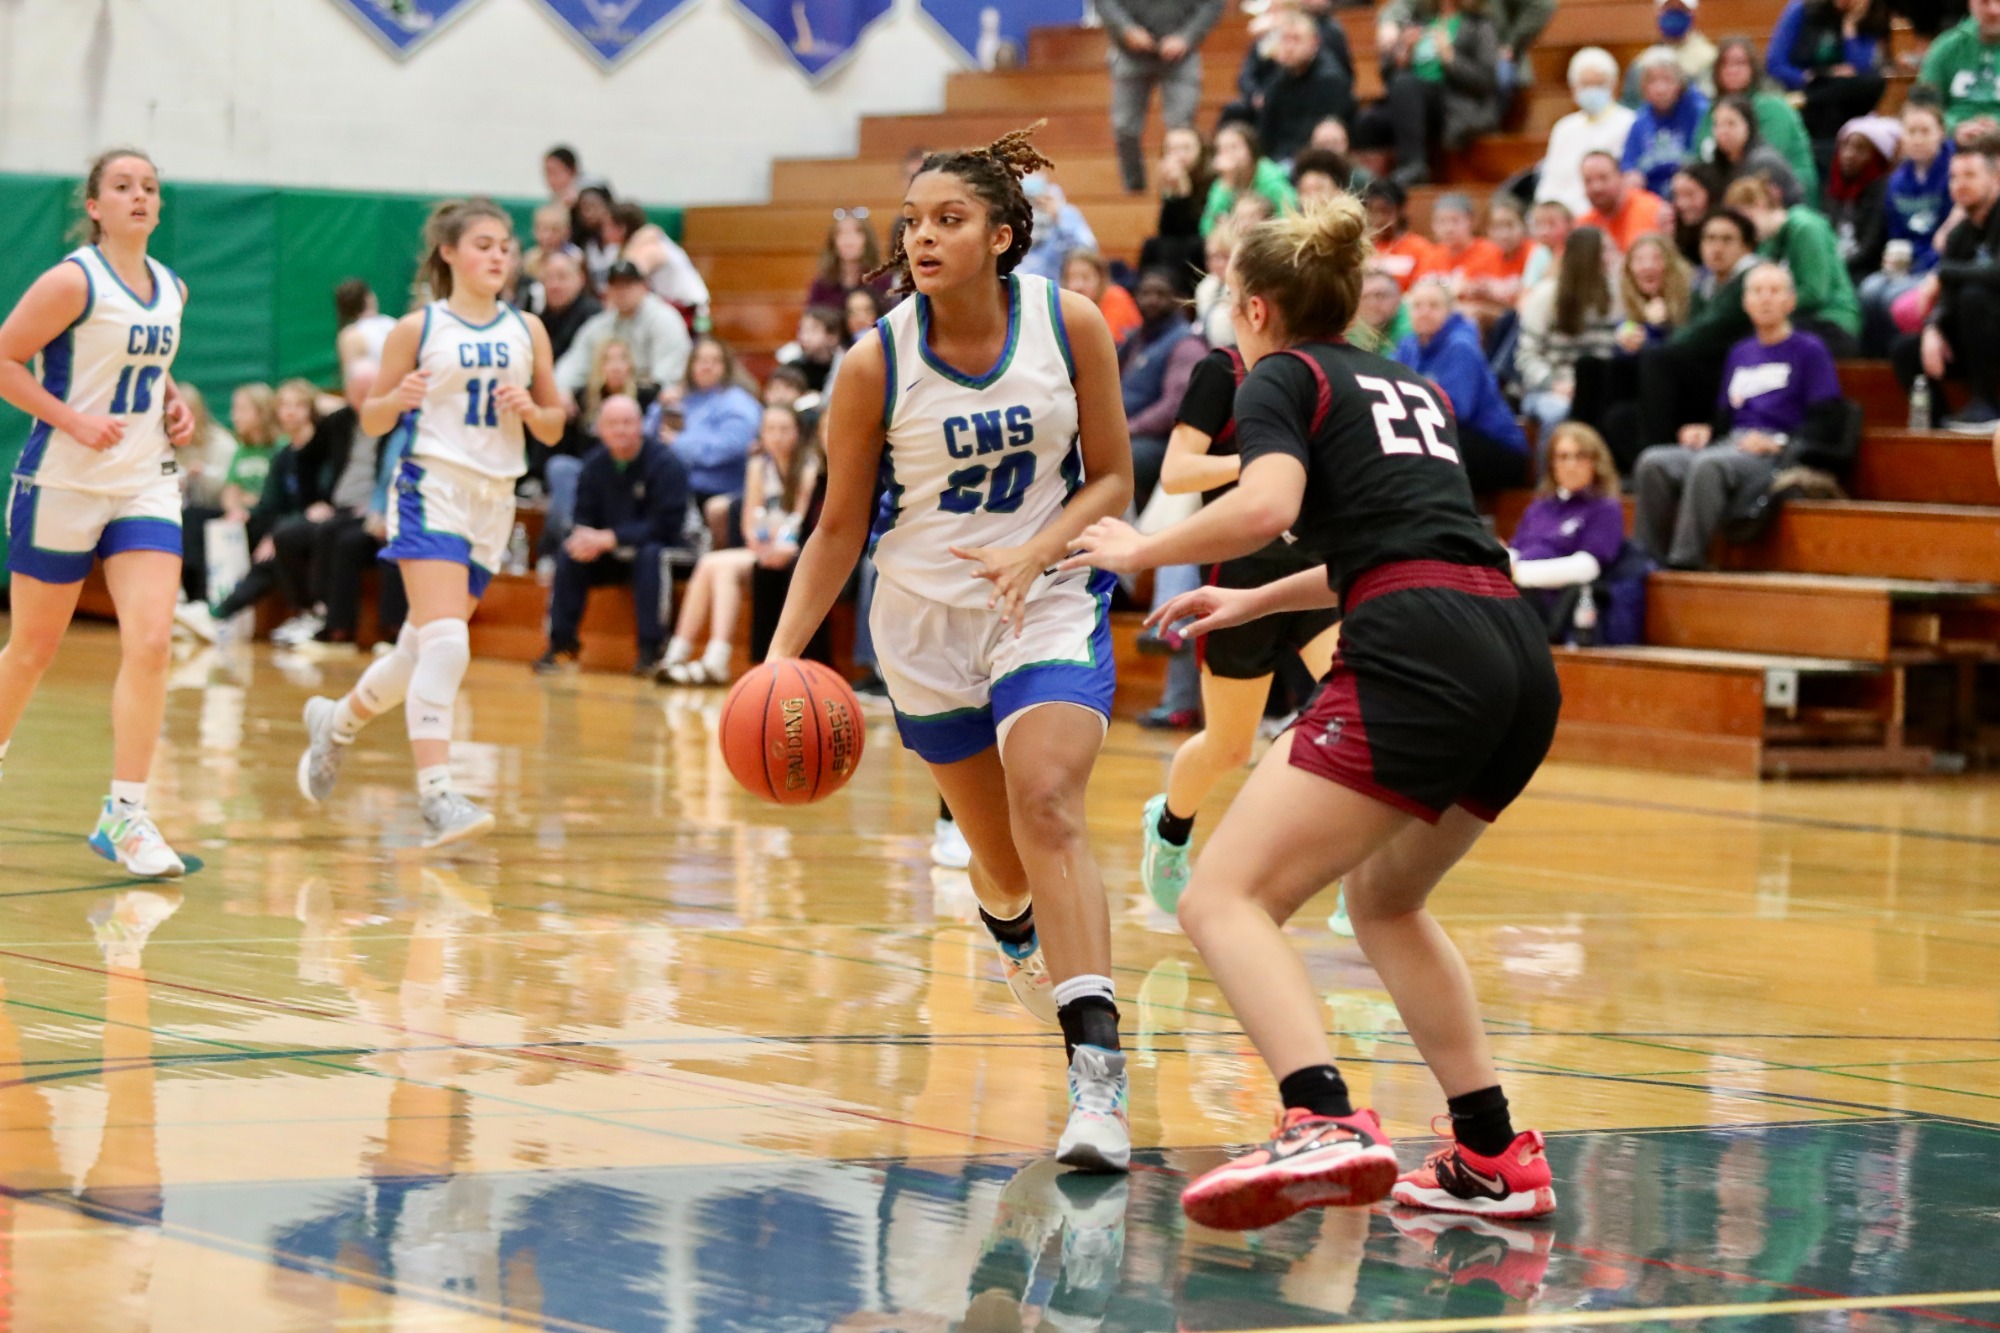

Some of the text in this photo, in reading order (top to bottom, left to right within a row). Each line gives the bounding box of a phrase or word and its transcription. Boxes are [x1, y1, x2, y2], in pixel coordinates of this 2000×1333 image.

[127, 325, 173, 356] CNS
[459, 342, 509, 368] CNS
[943, 405, 1034, 459] CNS
[1354, 373, 1459, 464] 22
[937, 450, 1037, 515] 20
[780, 698, 810, 791] SPALDING
[824, 699, 845, 778] EGACY
